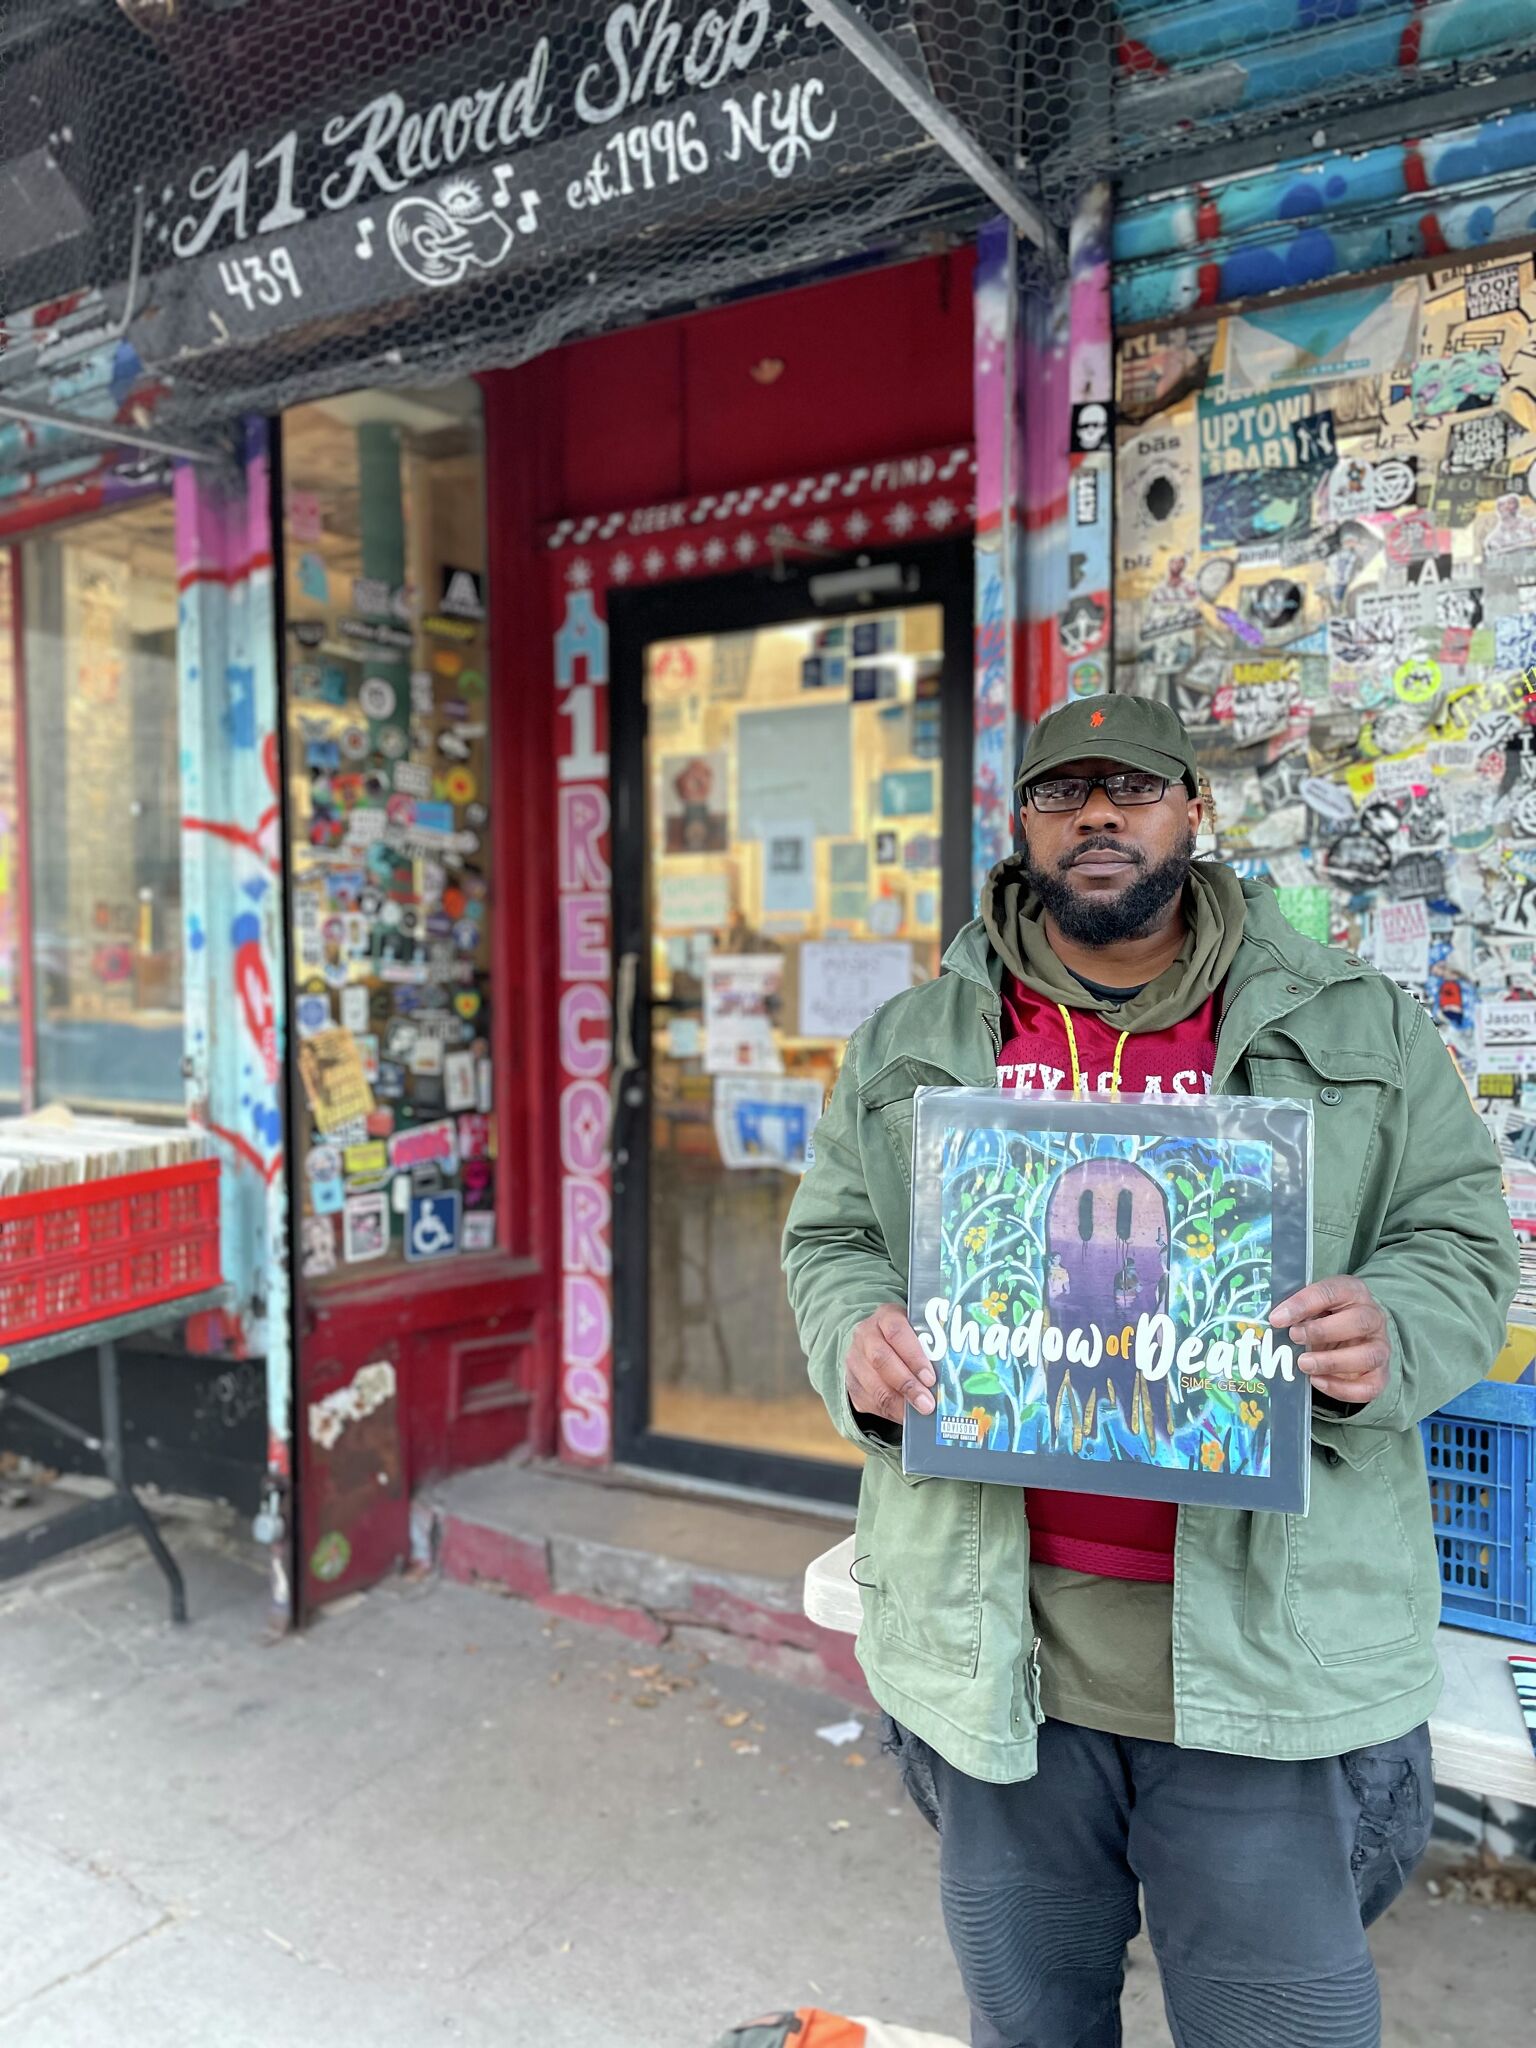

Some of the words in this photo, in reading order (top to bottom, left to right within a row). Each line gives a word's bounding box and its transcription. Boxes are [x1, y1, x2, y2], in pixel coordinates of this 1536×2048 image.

[173, 130, 306, 258] A1
[320, 37, 550, 210] Record
[575, 0, 769, 123] Shop
[721, 78, 837, 179] NYC
[218, 246, 303, 311] 439
[1467, 275, 1518, 297] LOOP
[870, 456, 936, 492] FIND
[628, 503, 686, 536] SEEK
[1486, 1011, 1530, 1027] Jason
[559, 784, 612, 1457] RECORDS
[917, 1297, 1102, 1368] Shadow
[1105, 1325, 1136, 1361] of
[1135, 1312, 1296, 1382] Death
[1181, 1376, 1213, 1390] SIME
[1217, 1380, 1266, 1394] GEZUS
[942, 1422, 978, 1434] ADVISORY
